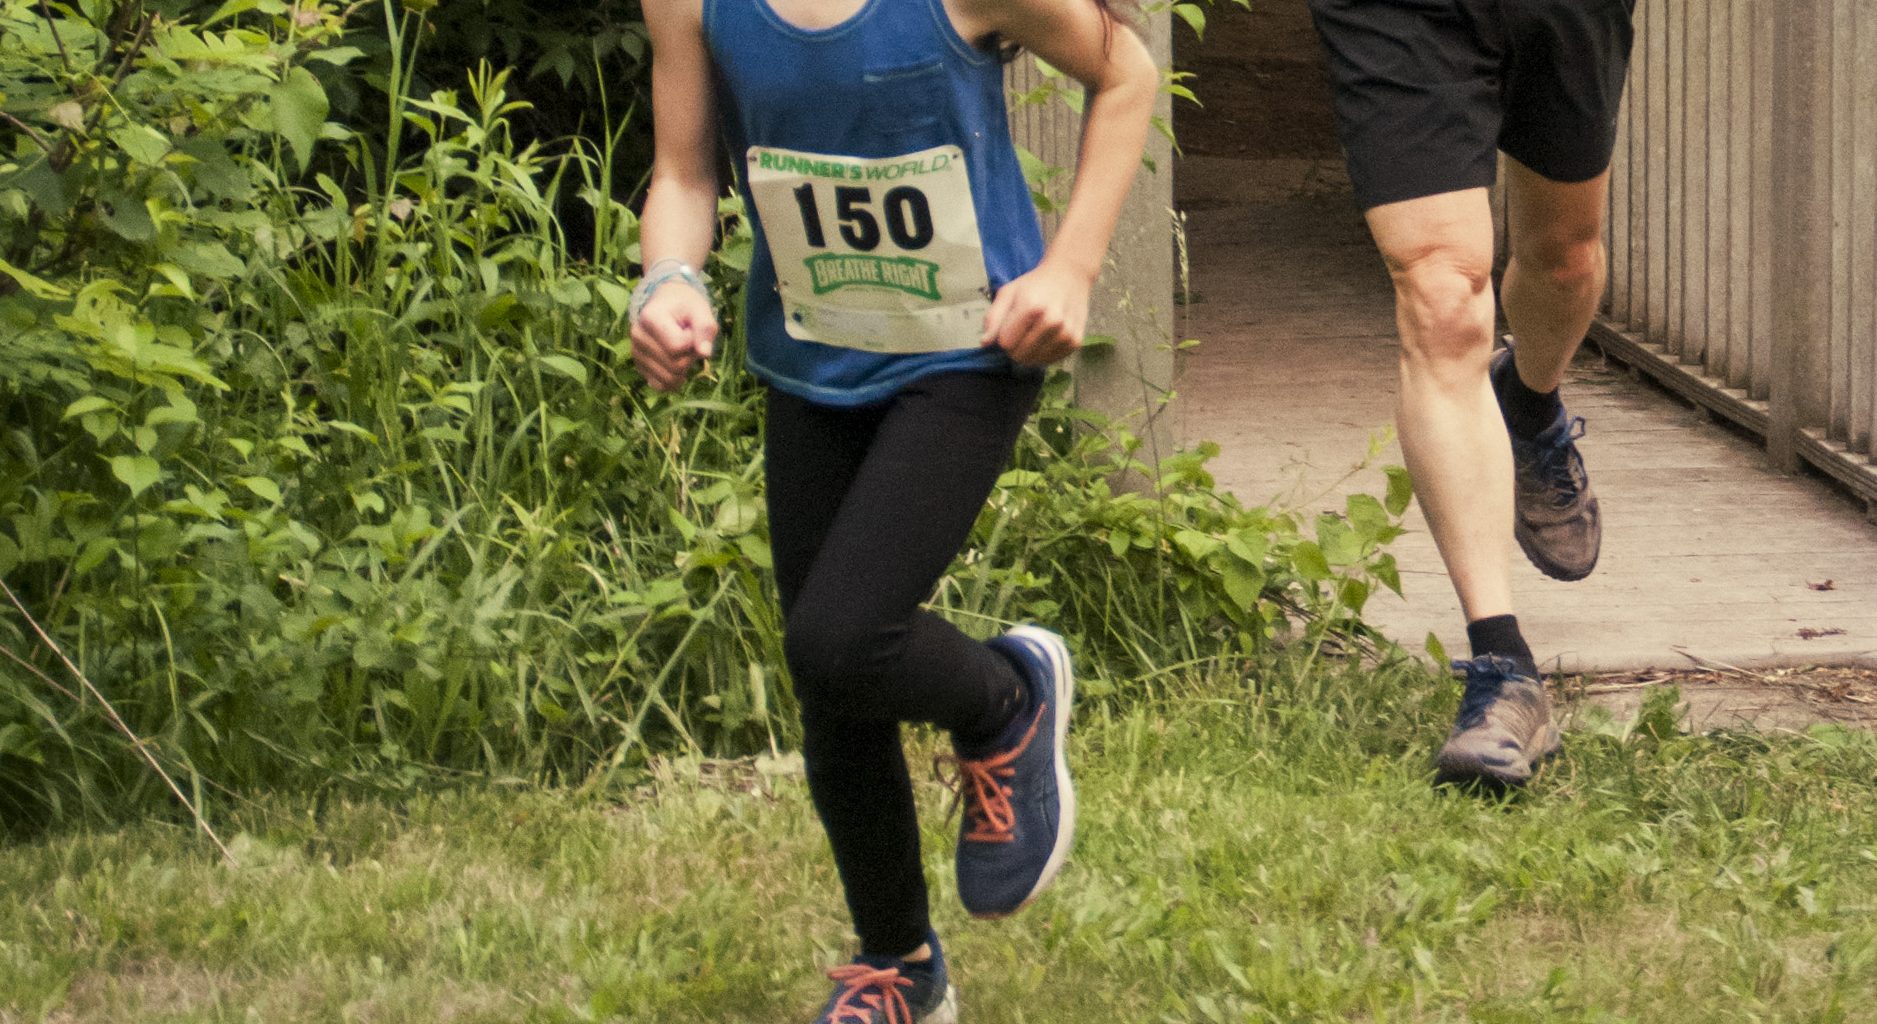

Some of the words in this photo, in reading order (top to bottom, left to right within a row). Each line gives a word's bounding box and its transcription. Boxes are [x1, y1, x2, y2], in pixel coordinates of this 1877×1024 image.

[759, 152, 862, 180] RUNNER'S
[866, 154, 949, 181] WORLD
[793, 182, 934, 252] 150
[814, 258, 880, 288] BREATHE
[880, 261, 931, 294] RIGHT
